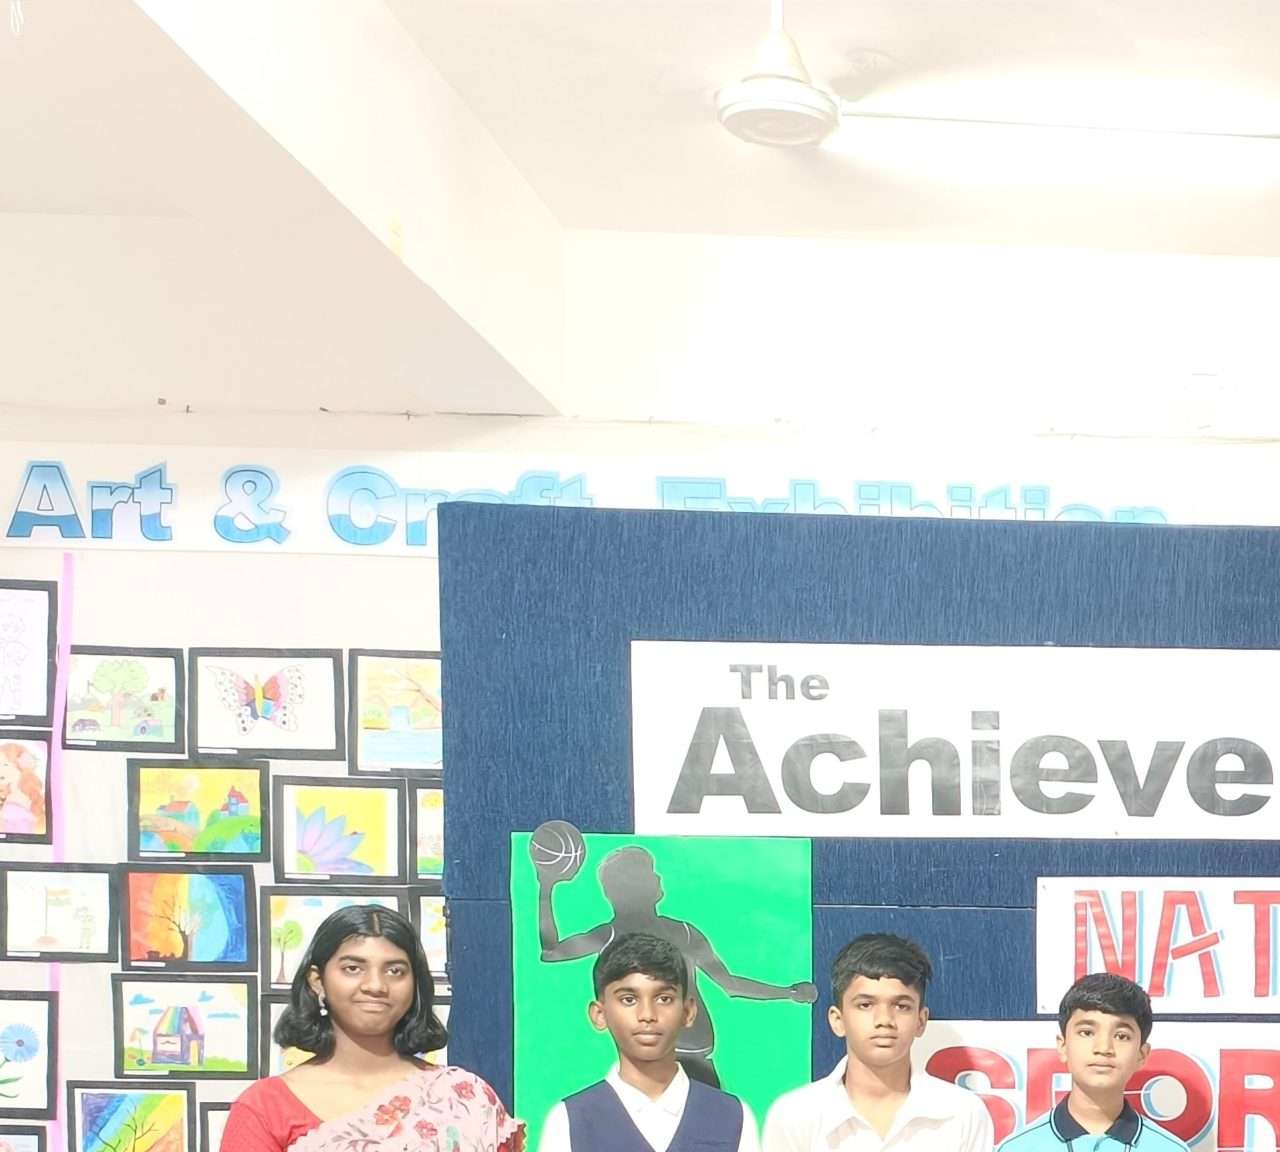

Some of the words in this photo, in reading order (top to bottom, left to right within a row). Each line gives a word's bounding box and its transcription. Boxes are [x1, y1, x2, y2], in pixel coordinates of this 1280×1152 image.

[6, 464, 173, 541] Art
[214, 468, 290, 544] &
[730, 664, 829, 701] The
